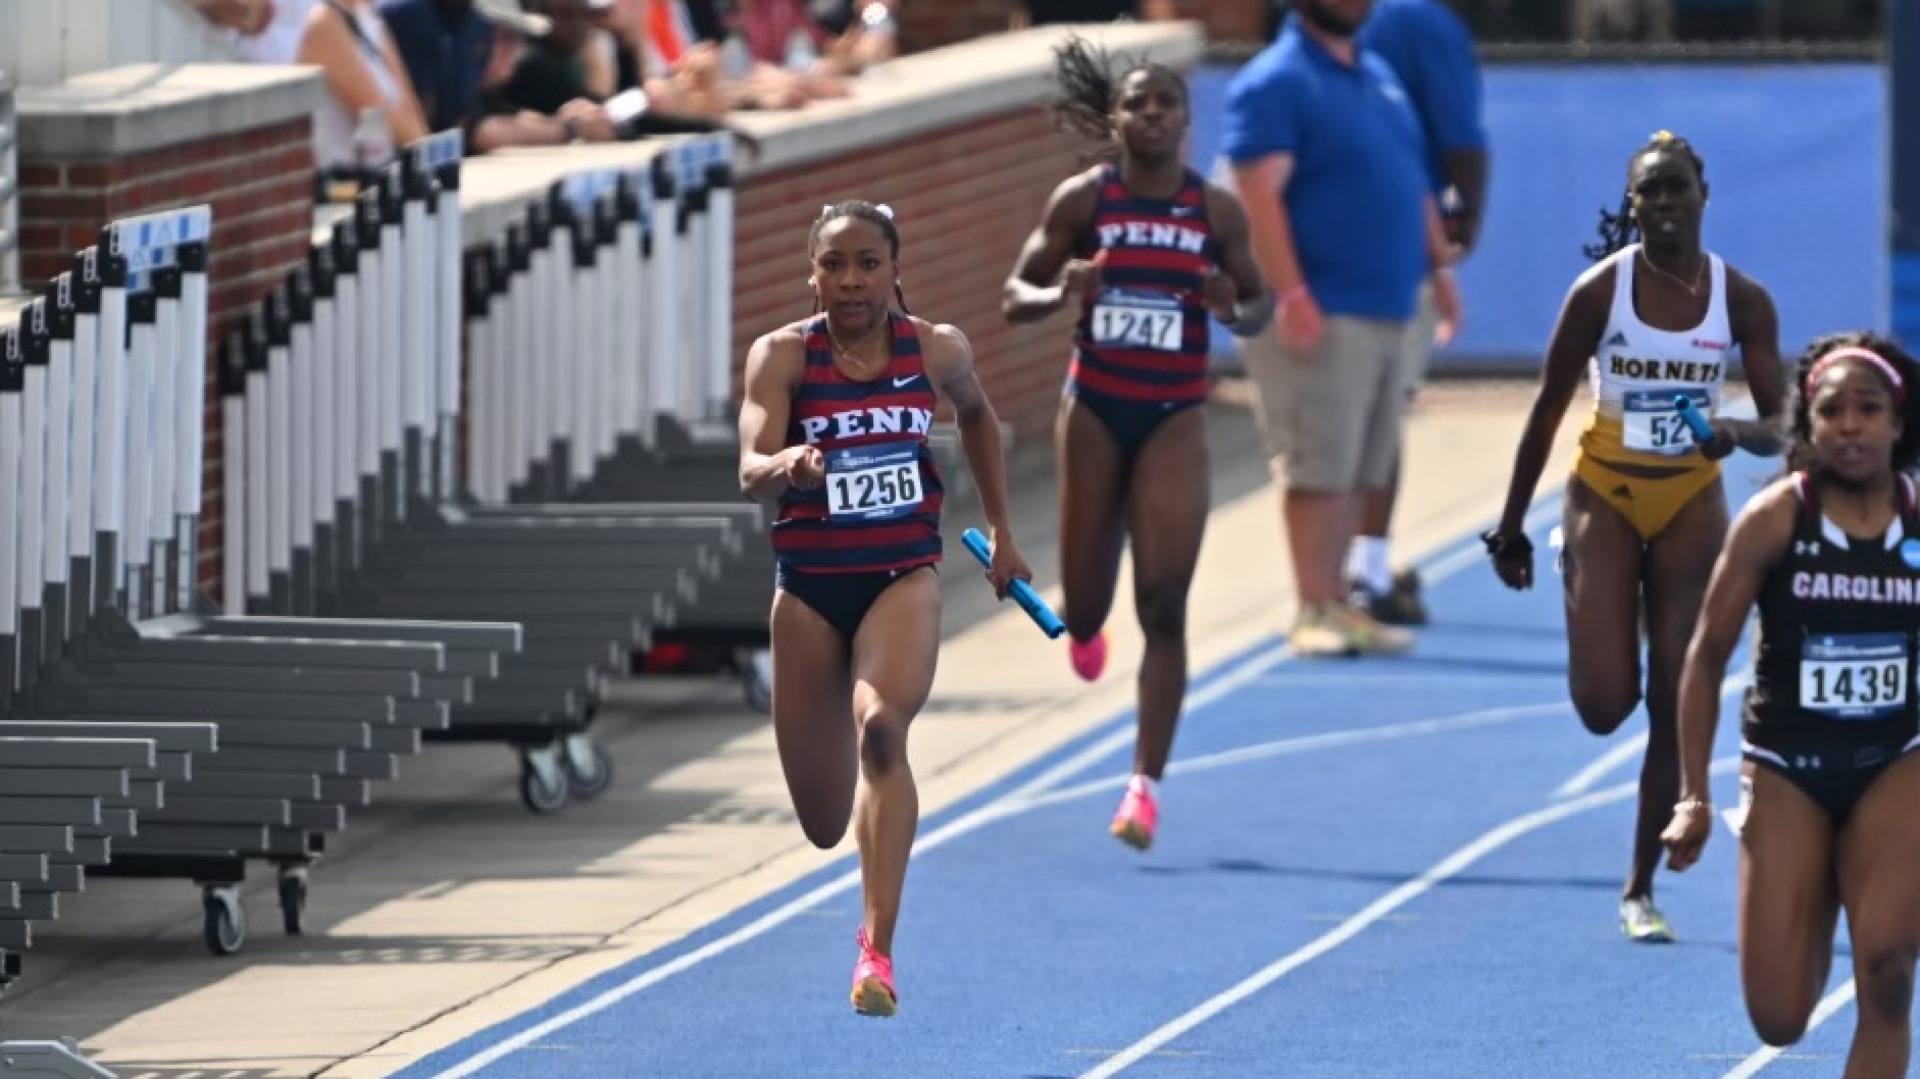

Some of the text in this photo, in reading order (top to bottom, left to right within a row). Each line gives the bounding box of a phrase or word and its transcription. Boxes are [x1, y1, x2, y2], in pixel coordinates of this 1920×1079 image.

[1098, 221, 1207, 254] PENN
[1102, 312, 1175, 346] 1247
[801, 406, 933, 443] PENN
[835, 466, 916, 510] 1256
[1811, 664, 1901, 703] 1439
